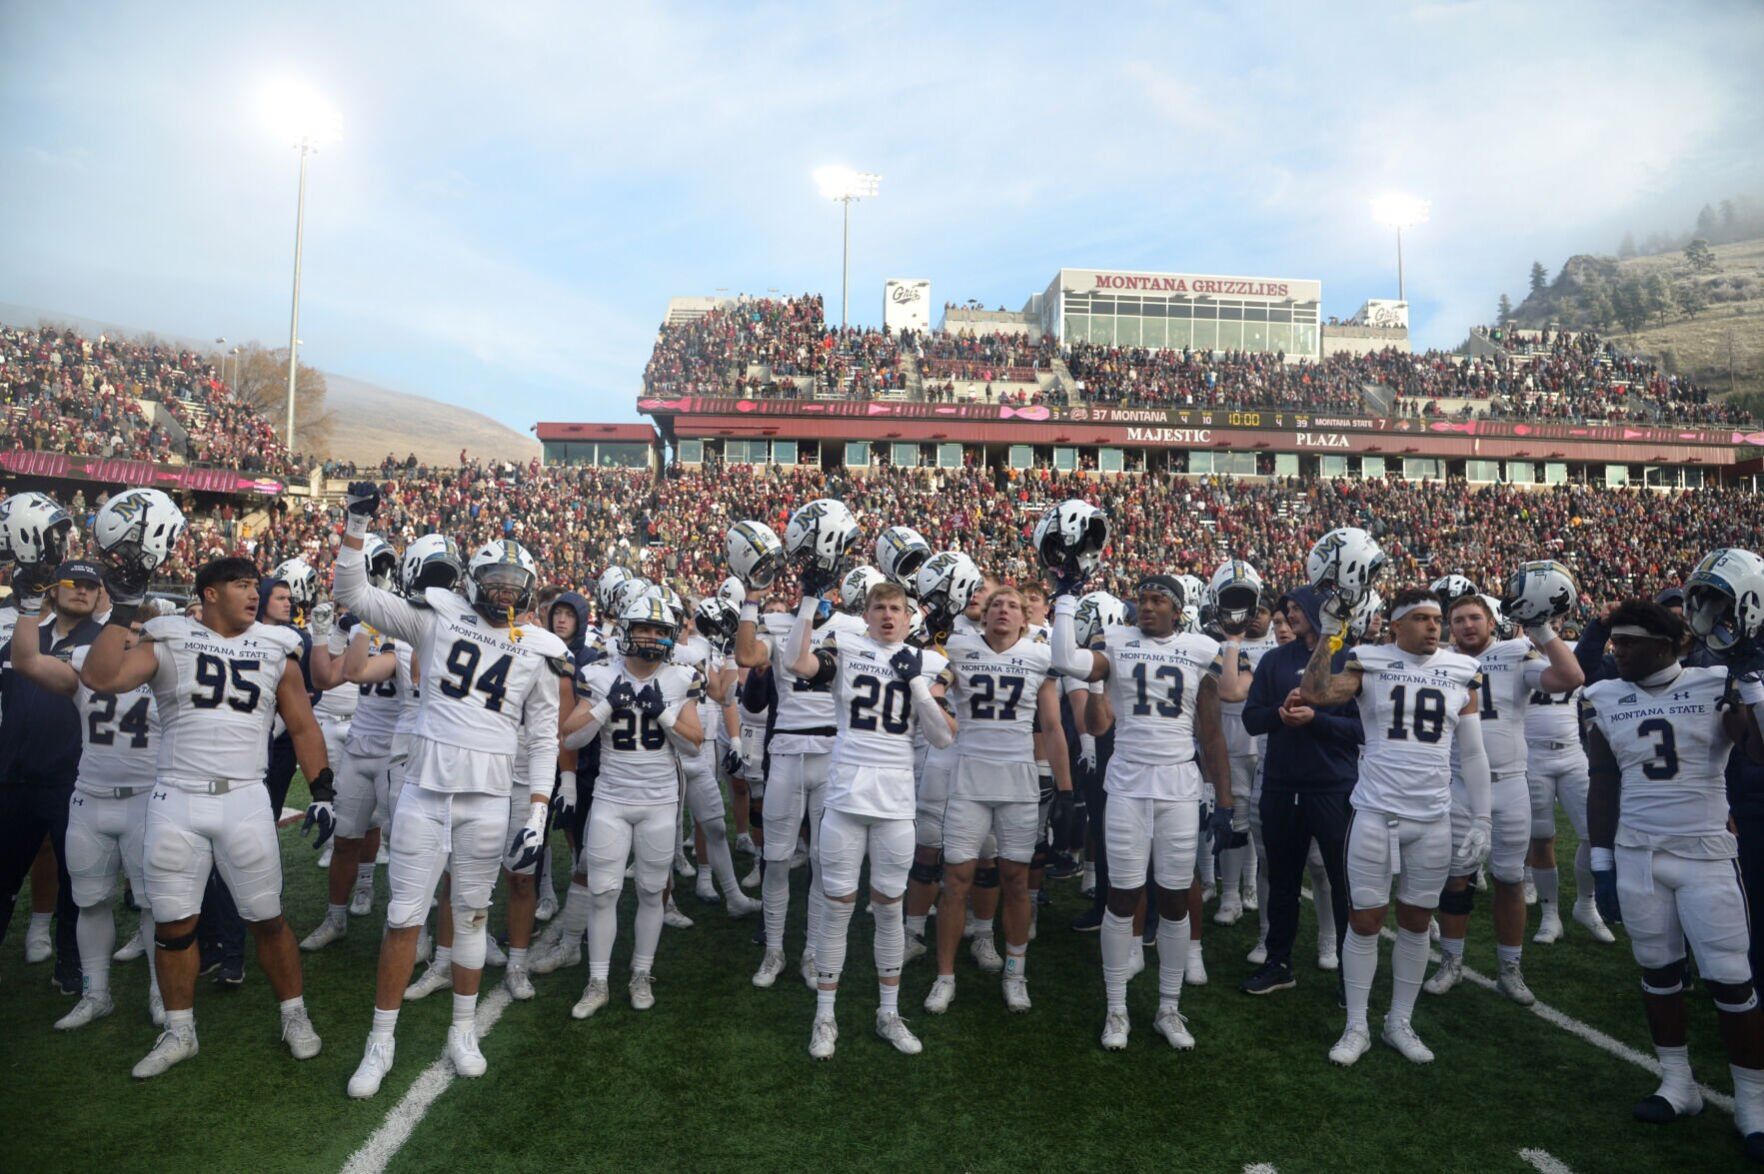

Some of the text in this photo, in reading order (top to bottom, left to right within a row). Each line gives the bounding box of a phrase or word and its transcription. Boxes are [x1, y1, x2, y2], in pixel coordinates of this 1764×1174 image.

[1095, 275, 1289, 296] MONTANA GRIZZLIES
[1053, 411, 1060, 420] 3
[1092, 410, 1107, 420] 37
[1111, 411, 1168, 422] MONTANA
[1181, 415, 1188, 424] 4
[1202, 416, 1212, 425] 10
[1228, 413, 1260, 426] 10:00
[1276, 419, 1283, 428] 4
[1296, 419, 1307, 428] 39
[1314, 418, 1374, 428] MONTANA STATE
[1378, 420, 1386, 430] 7
[1127, 427, 1350, 447] MAJESTIC PLAZA
[449, 624, 528, 657] MONTANA STATE
[184, 641, 269, 660] MONTANA STATE
[1120, 652, 1196, 667] MONTANA STATE
[1483, 664, 1508, 672] STATE
[439, 639, 514, 713] 94
[849, 662, 894, 677] MONTANA
[961, 664, 1029, 675] MONTANA STATE
[191, 652, 261, 714] 95
[1132, 662, 1183, 718] 13
[1379, 673, 1456, 690] MONTANA STATE
[850, 674, 911, 735] 20
[969, 673, 1025, 720] 27
[1480, 672, 1499, 720] 1
[88, 691, 151, 749] 24
[1387, 685, 1446, 743] 18
[1610, 705, 1706, 723] MONTANA STATE
[1637, 718, 1680, 781] 3
